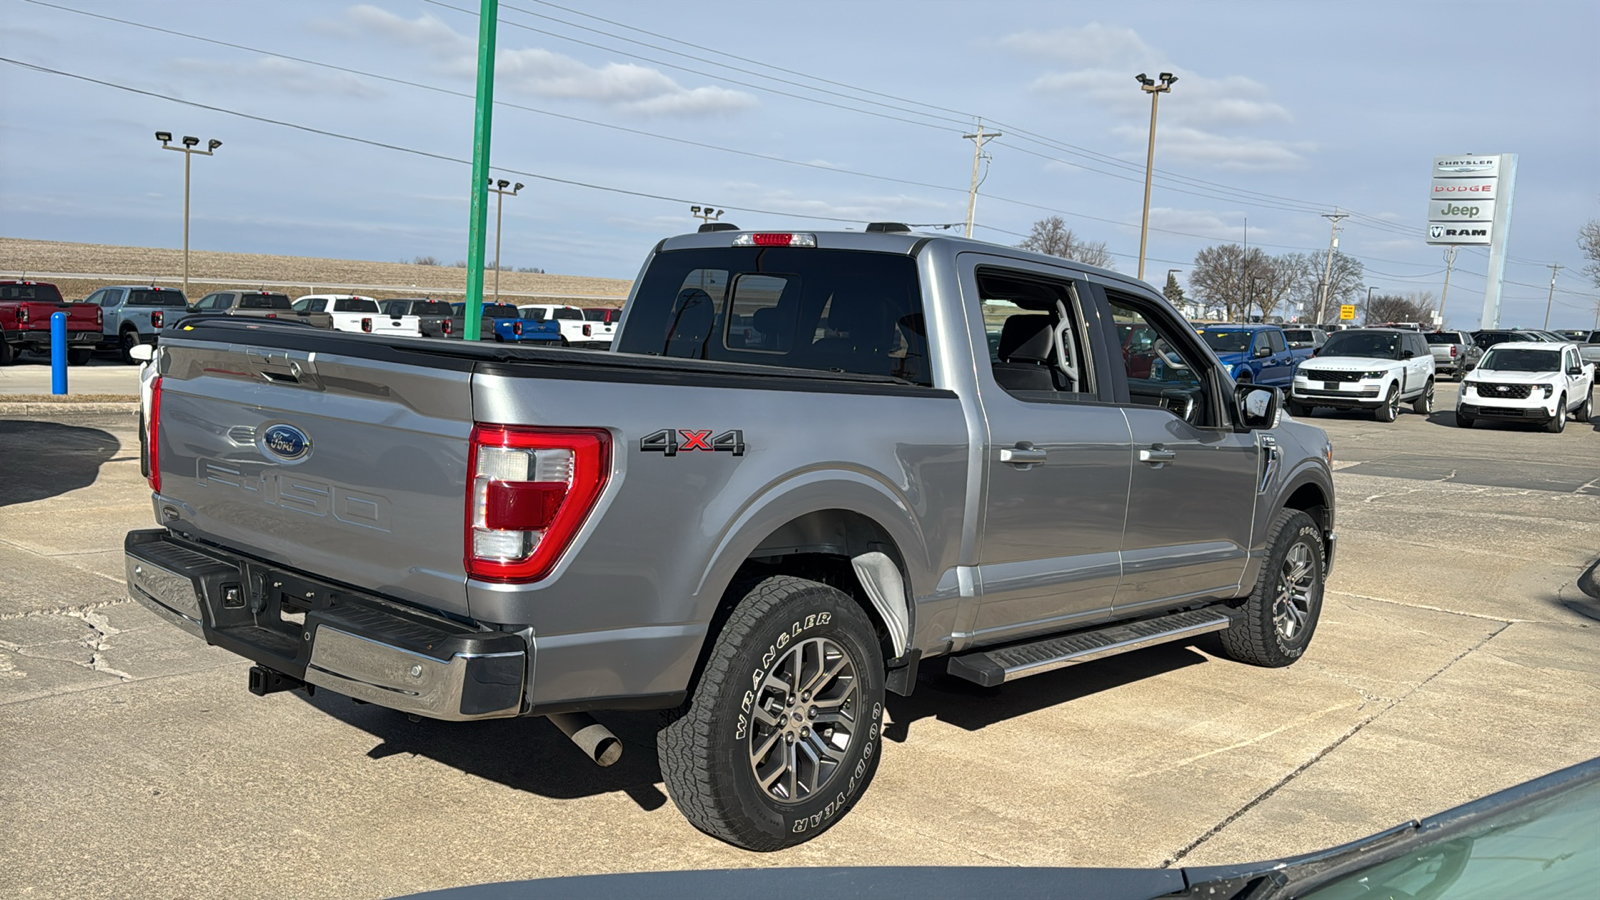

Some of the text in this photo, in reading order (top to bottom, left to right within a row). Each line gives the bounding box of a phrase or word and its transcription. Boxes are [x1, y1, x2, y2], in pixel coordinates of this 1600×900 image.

[1441, 203, 1480, 218] Jeep
[270, 430, 297, 452] Ford
[736, 612, 832, 740] WRANGLER
[792, 702, 882, 833] GOODYEAR
